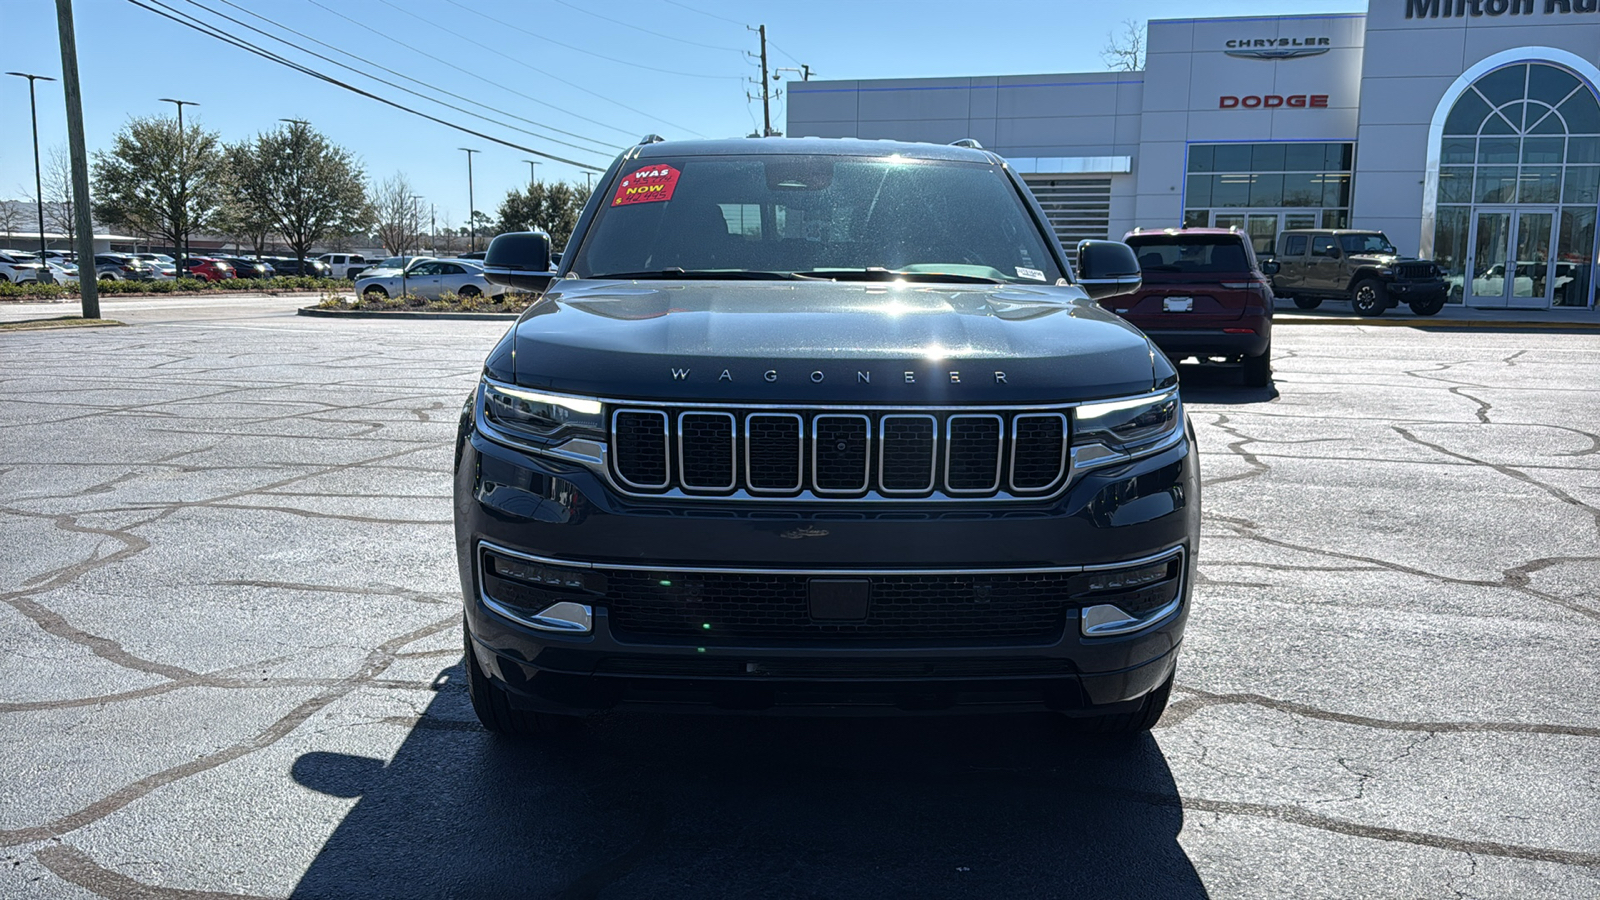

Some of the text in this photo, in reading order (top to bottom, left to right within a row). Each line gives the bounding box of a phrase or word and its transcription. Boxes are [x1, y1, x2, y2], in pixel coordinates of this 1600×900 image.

[1543, 0, 1600, 14] Ru
[1225, 37, 1330, 48] CHRYSLER
[1219, 94, 1329, 109] DODGE
[635, 169, 669, 179] WAS
[622, 180, 630, 188] $
[626, 184, 665, 195] NOW
[615, 197, 622, 205] $
[671, 367, 1009, 384] WAGONEER
